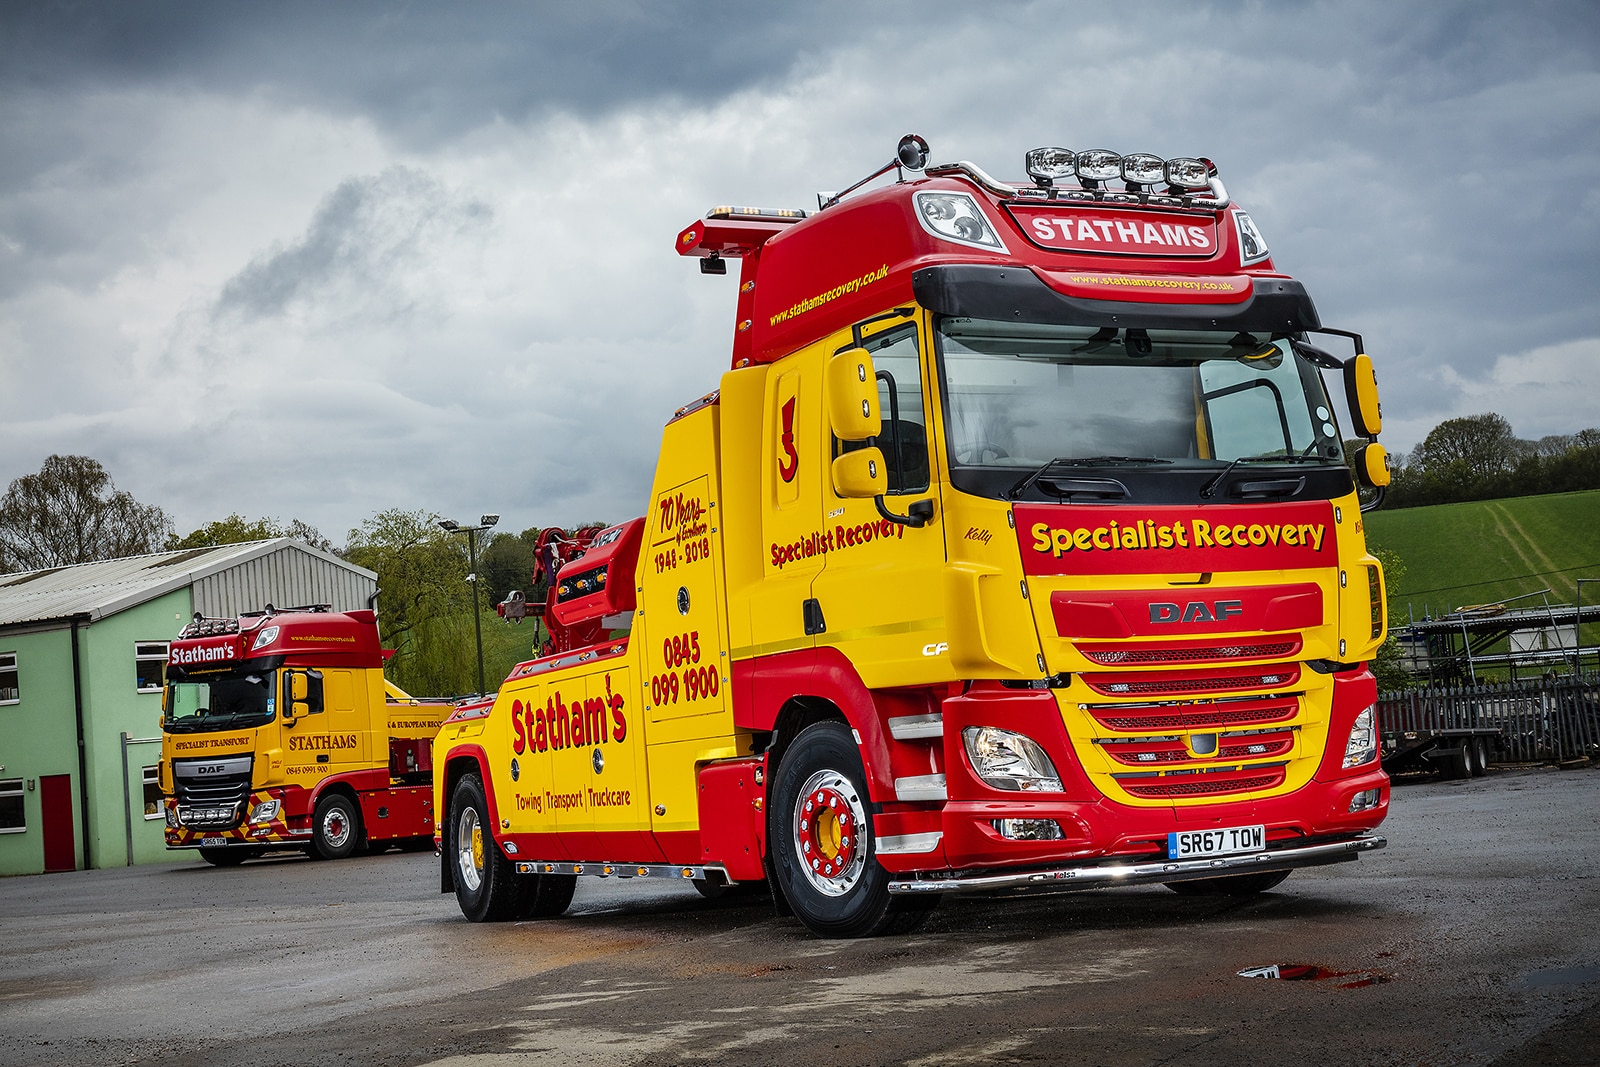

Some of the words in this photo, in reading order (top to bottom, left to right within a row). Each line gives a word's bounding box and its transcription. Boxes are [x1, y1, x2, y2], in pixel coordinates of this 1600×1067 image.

[1031, 217, 1210, 248] STATHAMS
[769, 263, 889, 327] www.stathamsrecovery.co.uk
[1070, 275, 1235, 291] www.stathamsrecovery.co.uk
[660, 496, 674, 534] 70
[675, 492, 701, 527] Years
[771, 529, 834, 570] Specialist
[835, 512, 905, 551] Recovery
[964, 526, 993, 546] Kelly
[1031, 519, 1189, 558] Specialist
[1191, 519, 1325, 551] Recovery
[654, 548, 677, 574] 1948
[685, 537, 710, 564] 2018
[1148, 600, 1243, 624] DAF
[171, 641, 235, 665] Statham's
[663, 630, 701, 669] 0845
[922, 641, 950, 657] CF
[651, 673, 680, 707] 099
[682, 664, 719, 702] 1900
[511, 673, 628, 756] Statham's
[175, 740, 209, 751] SPECIALIST
[210, 737, 250, 748] TRANSPORT
[289, 735, 357, 751] STATHAMS
[198, 765, 225, 774] DAF
[286, 767, 301, 775] 0845
[302, 766, 317, 774] 0991
[317, 765, 328, 774] 900
[515, 792, 542, 814] Towing
[546, 790, 583, 812] Transport
[588, 787, 631, 807] Truckcare
[1180, 832, 1224, 854] SR67
[1230, 827, 1262, 849] TOW
[1053, 871, 1076, 879] Kelsa
